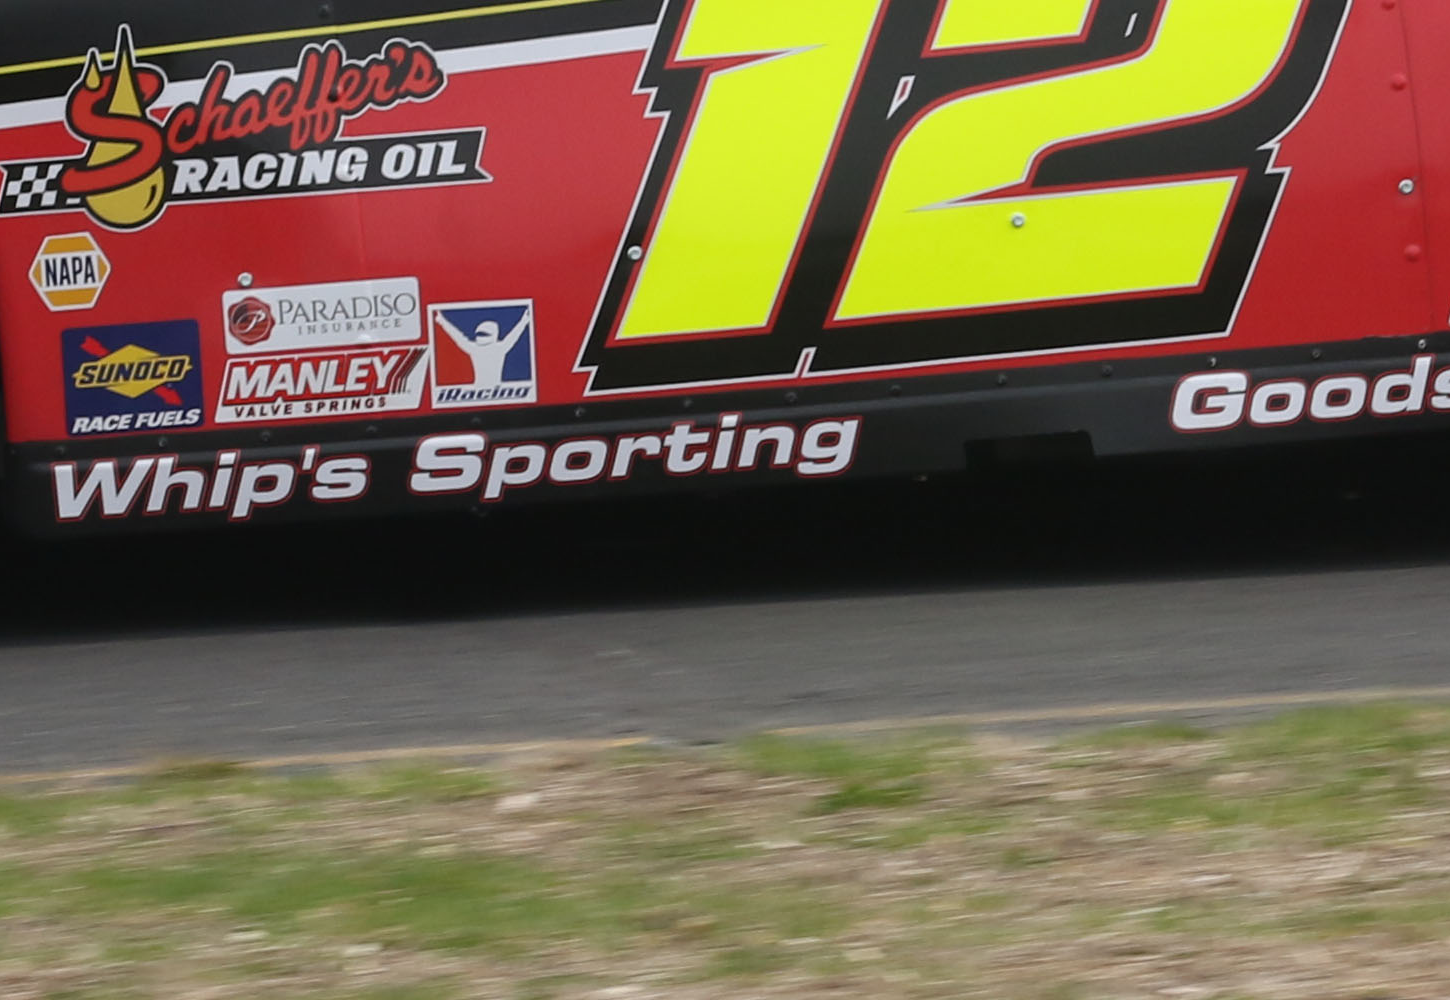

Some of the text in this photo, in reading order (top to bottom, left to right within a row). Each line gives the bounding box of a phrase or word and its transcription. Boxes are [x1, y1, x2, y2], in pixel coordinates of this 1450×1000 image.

[61, 43, 443, 193] Schaeffer's
[170, 139, 468, 196] RACING OIL
[44, 255, 97, 288] NAPA
[277, 292, 417, 325] PARADISO
[297, 318, 403, 336] INSURANCE
[78, 358, 189, 385] SUNOCO
[226, 349, 400, 400] MANLEY
[234, 396, 388, 419] VALVE SPRINGS
[436, 384, 533, 404] iRacing
[71, 408, 202, 434] RACE FUELS
[52, 443, 371, 522] Whip's
[410, 415, 862, 505] Sporting
